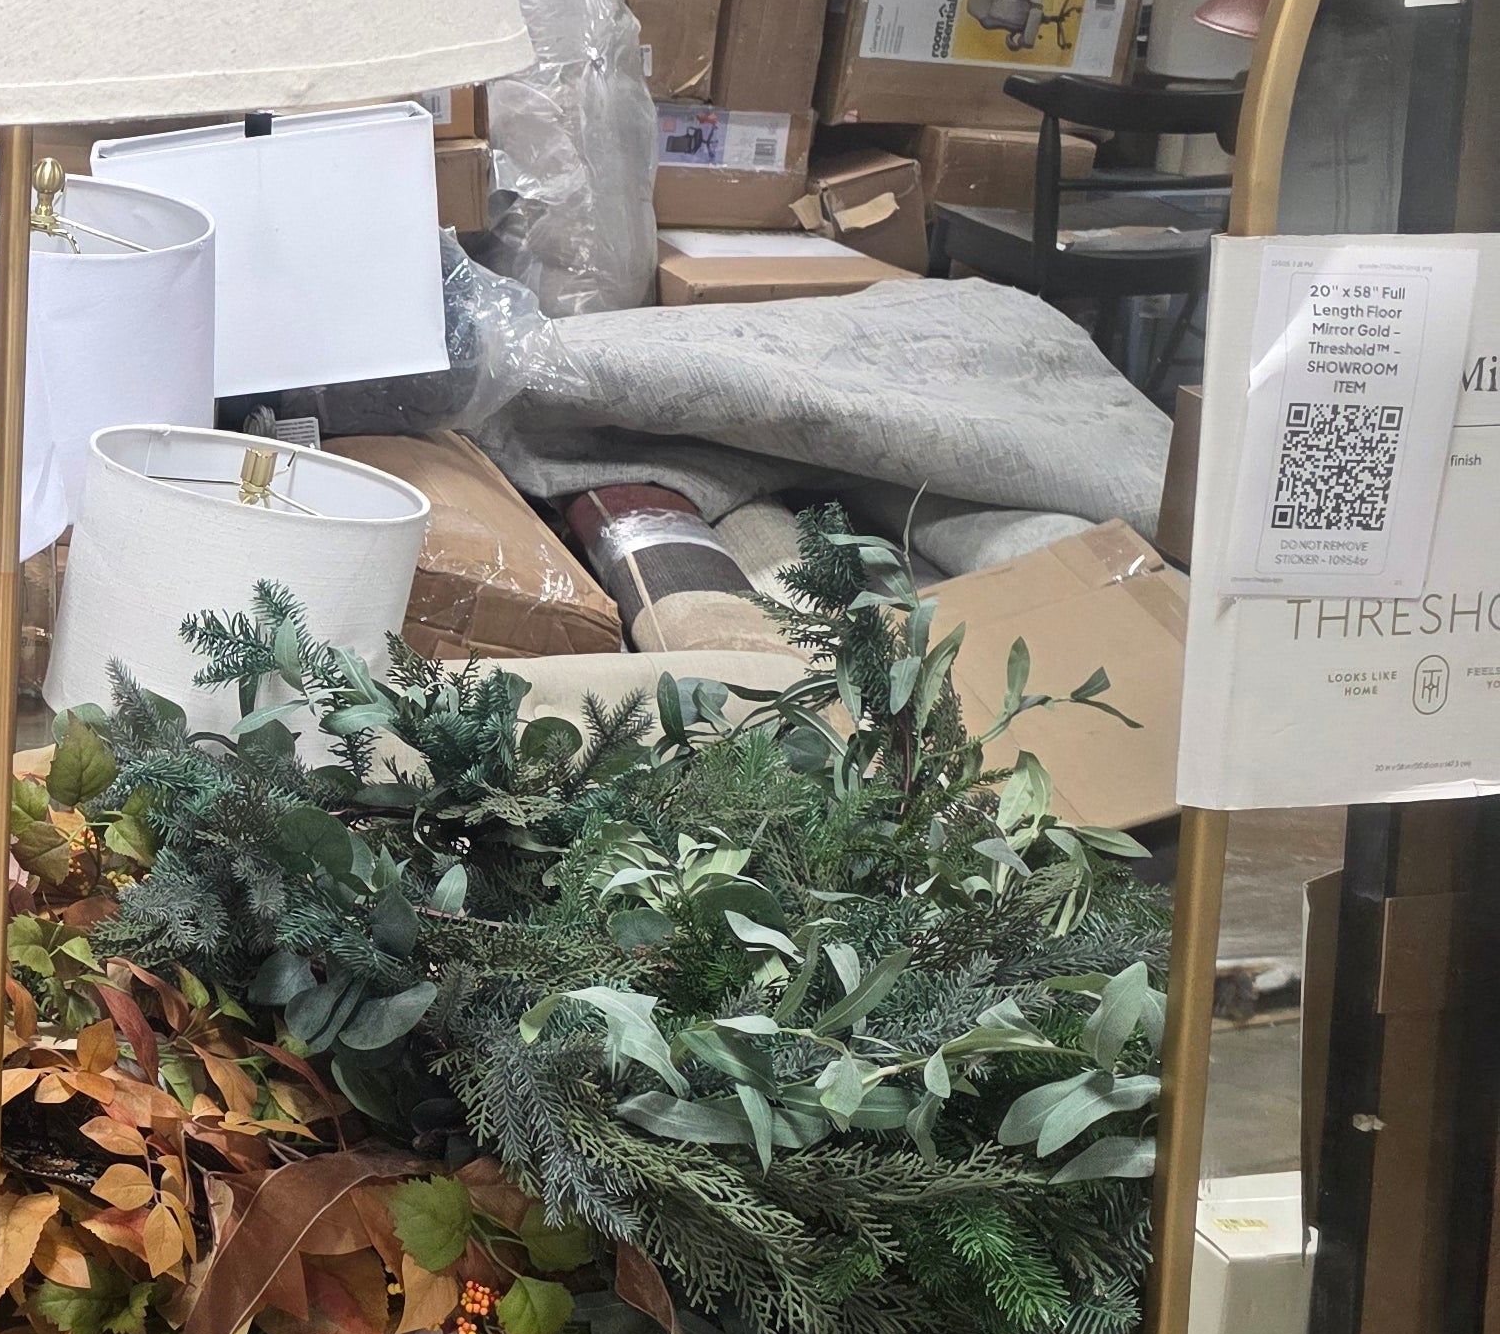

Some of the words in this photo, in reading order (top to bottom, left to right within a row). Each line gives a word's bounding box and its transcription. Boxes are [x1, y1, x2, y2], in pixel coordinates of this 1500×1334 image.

[932, 20, 945, 58] room
[1310, 284, 1339, 298] 20"
[1342, 288, 1351, 298] x
[1353, 285, 1380, 299] 58"
[1382, 286, 1406, 300] Full
[1313, 303, 1364, 320] Length
[1367, 305, 1403, 319] Floor
[1312, 322, 1356, 336] Mirror
[1357, 324, 1391, 338] Gold
[1306, 360, 1399, 376] SHOWROOM
[1333, 380, 1366, 394] ITEM
[1450, 453, 1482, 468] finish
[1280, 539, 1298, 550] DO
[1299, 539, 1322, 551] NOT
[1323, 540, 1370, 552] REMOVE
[1274, 553, 1320, 565] STICKER
[1328, 671, 1367, 683] LOOKS
[1371, 670, 1398, 681] LIKE
[1344, 685, 1378, 696] HOME
